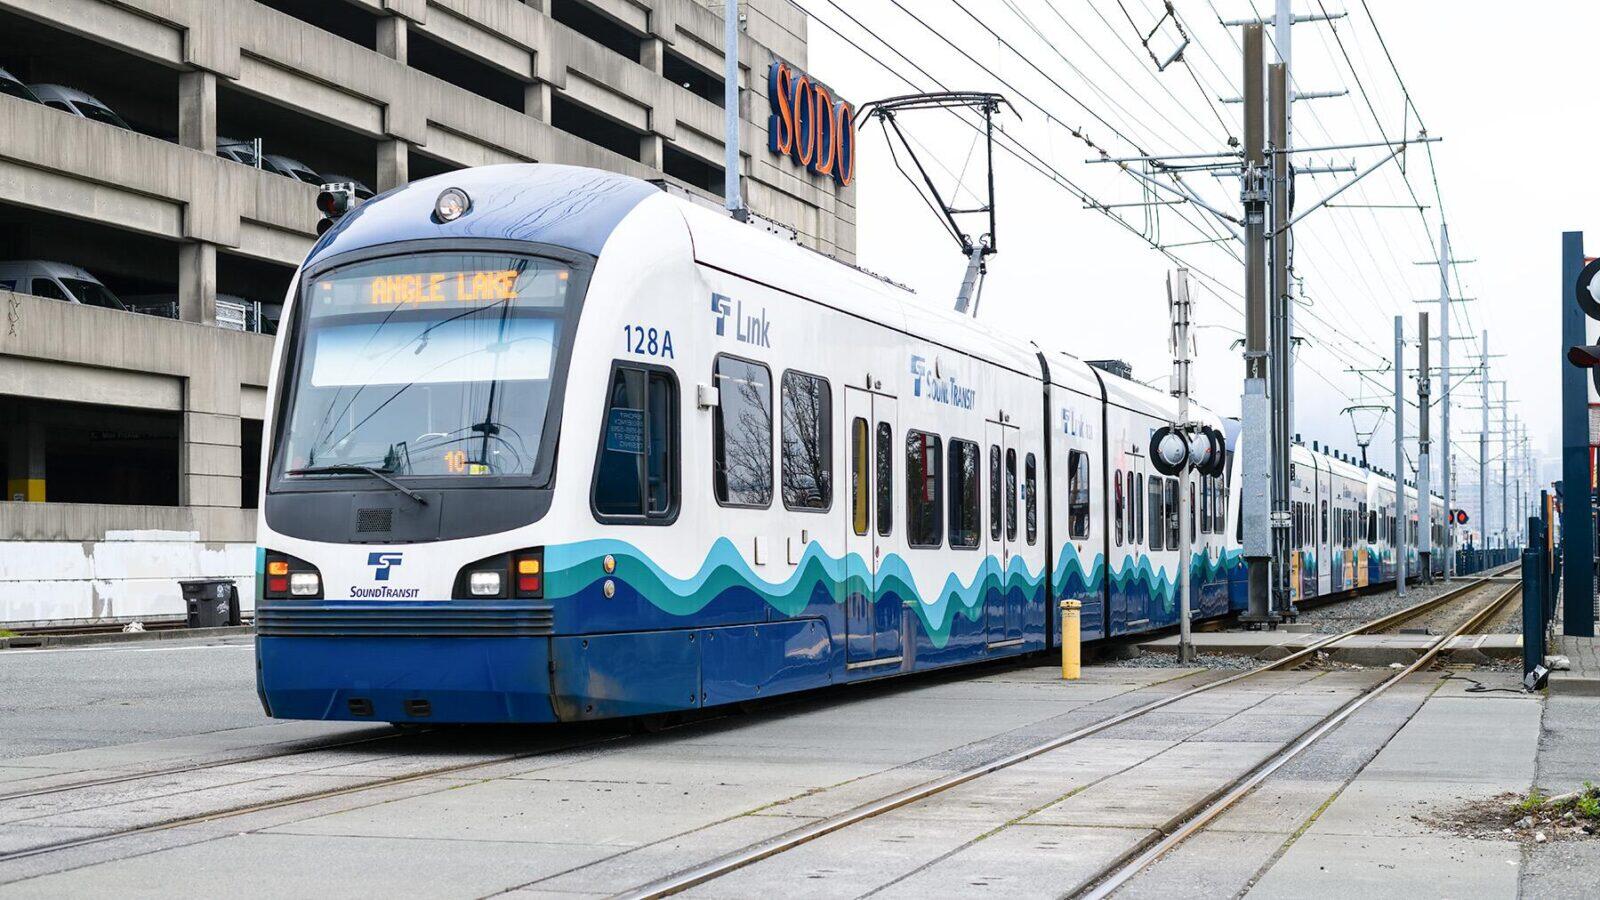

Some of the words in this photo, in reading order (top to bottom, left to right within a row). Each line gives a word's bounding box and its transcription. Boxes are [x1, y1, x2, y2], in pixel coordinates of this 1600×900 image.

[767, 61, 855, 187] SODO
[371, 273, 445, 305] ANGLE
[457, 270, 519, 300] LAKE
[624, 324, 674, 359] 128A
[736, 300, 771, 348] Link
[443, 450, 465, 473] 10
